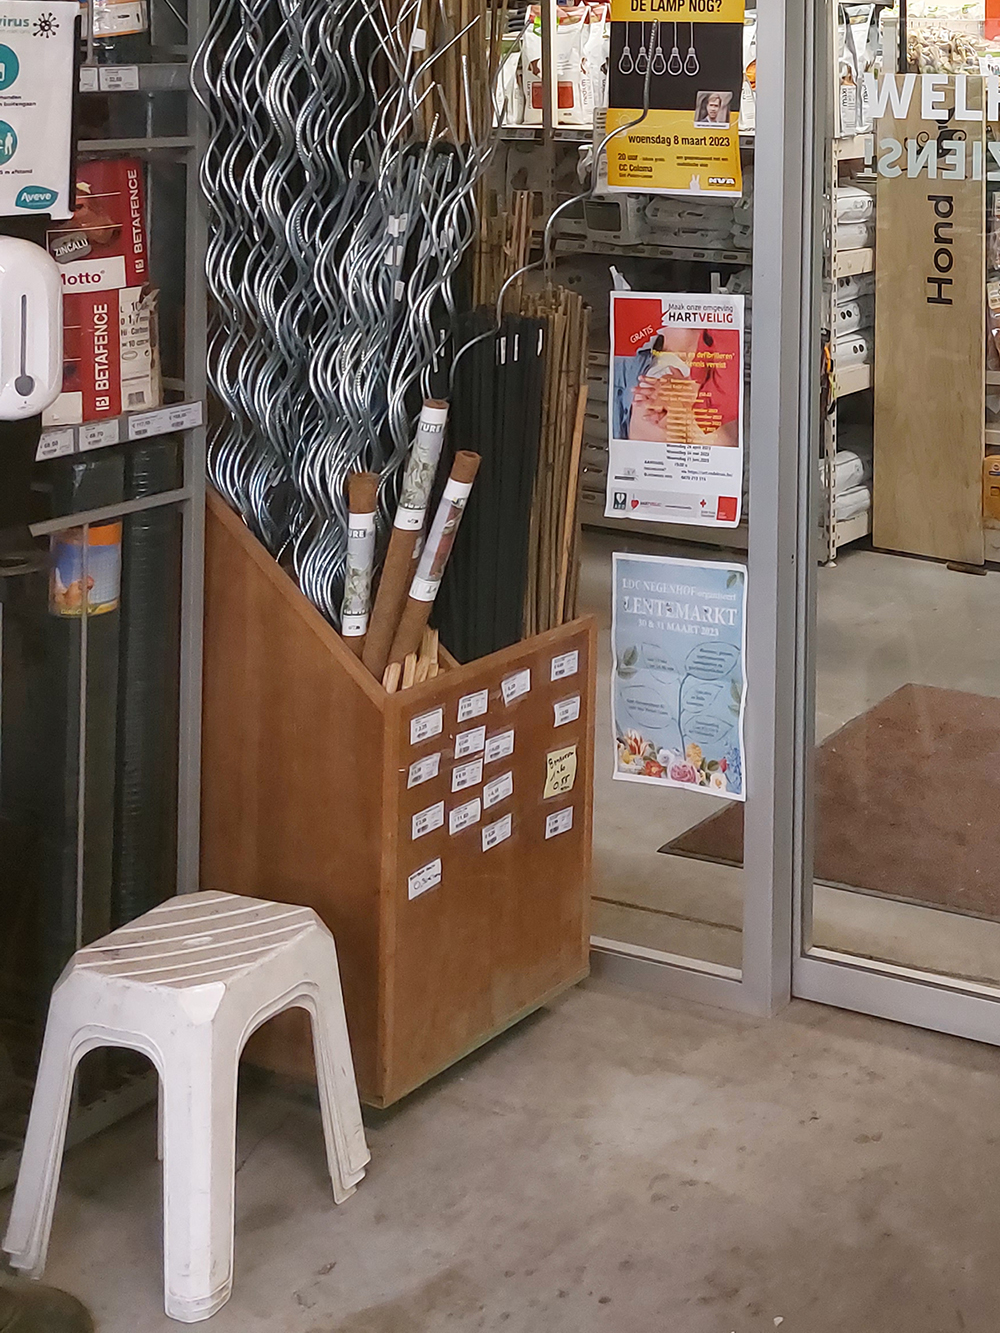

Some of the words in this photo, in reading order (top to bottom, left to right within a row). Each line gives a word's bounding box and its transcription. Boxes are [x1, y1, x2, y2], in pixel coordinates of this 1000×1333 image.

[631, 0, 647, 12] DE
[650, 0, 686, 13] LAMP
[688, 0, 723, 13] NOG?
[628, 135, 672, 147] woensdag
[673, 135, 680, 145] 8
[681, 137, 707, 146] maart
[709, 137, 730, 147] 2023
[618, 153, 626, 161] 20
[21, 192, 52, 203] Aveve
[127, 169, 144, 254] BETAFENCE
[53, 238, 89, 257] ZINCALU
[926, 194, 954, 306] Hond
[668, 312, 733, 324] HARTVEILIG
[630, 324, 654, 344] GRATIS
[93, 303, 109, 391] BETAFENCE
[623, 596, 738, 626] LENTEMARKT
[667, 622, 698, 635] MAART
[701, 627, 719, 637] 2023
